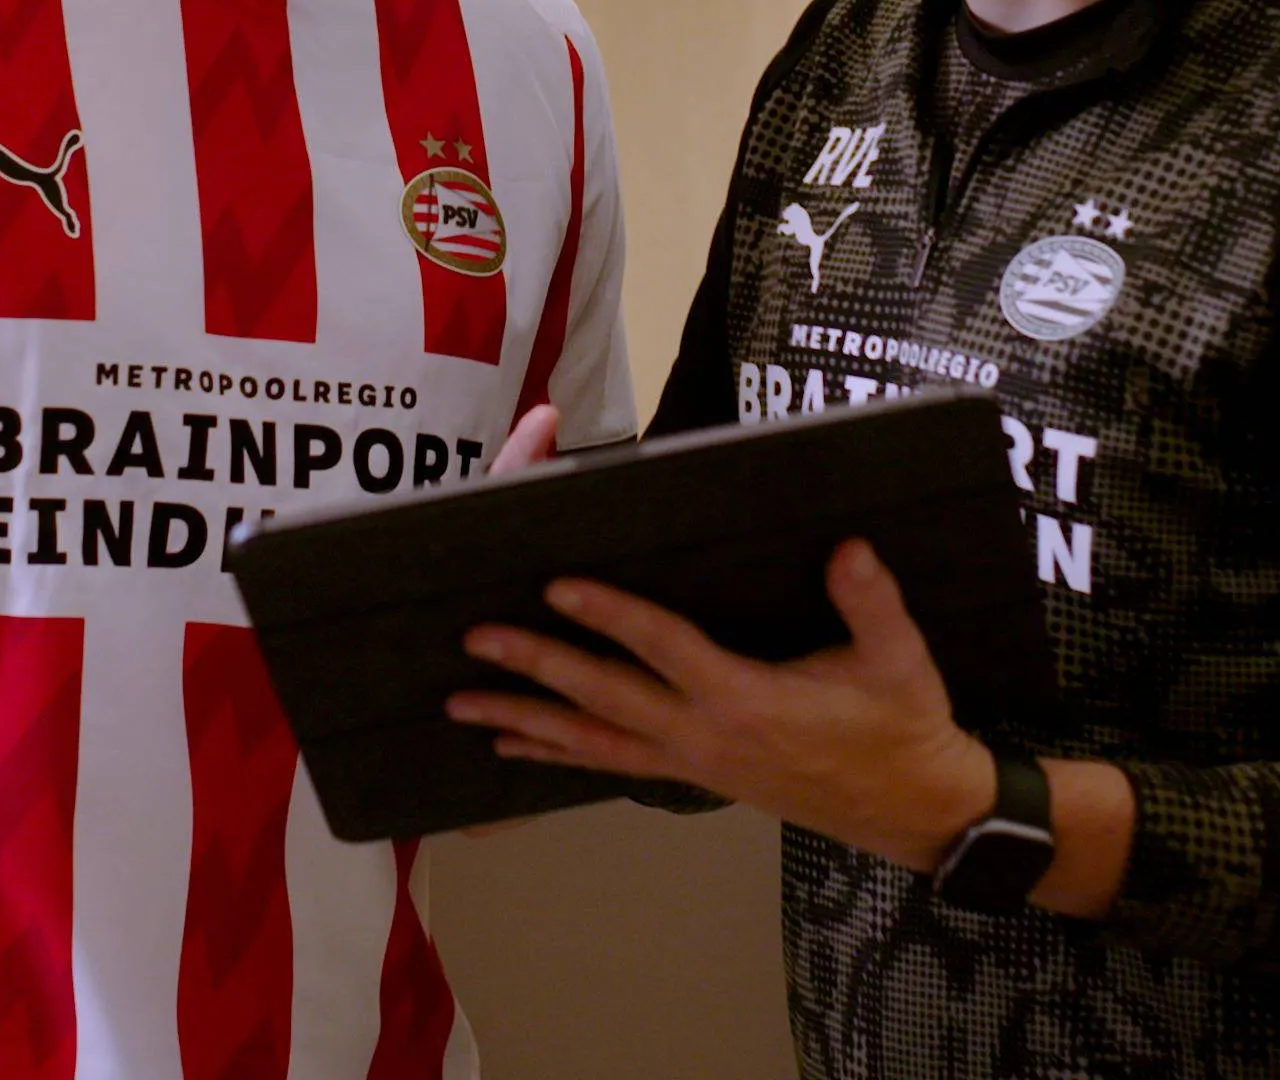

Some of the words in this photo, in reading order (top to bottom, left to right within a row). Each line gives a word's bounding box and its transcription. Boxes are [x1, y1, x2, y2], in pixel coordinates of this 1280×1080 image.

[442, 205, 478, 229] PSV
[1042, 271, 1091, 296] PSV
[791, 323, 1000, 389] METROPOOLREGIO
[95, 363, 417, 410] METROPOOLREGIO
